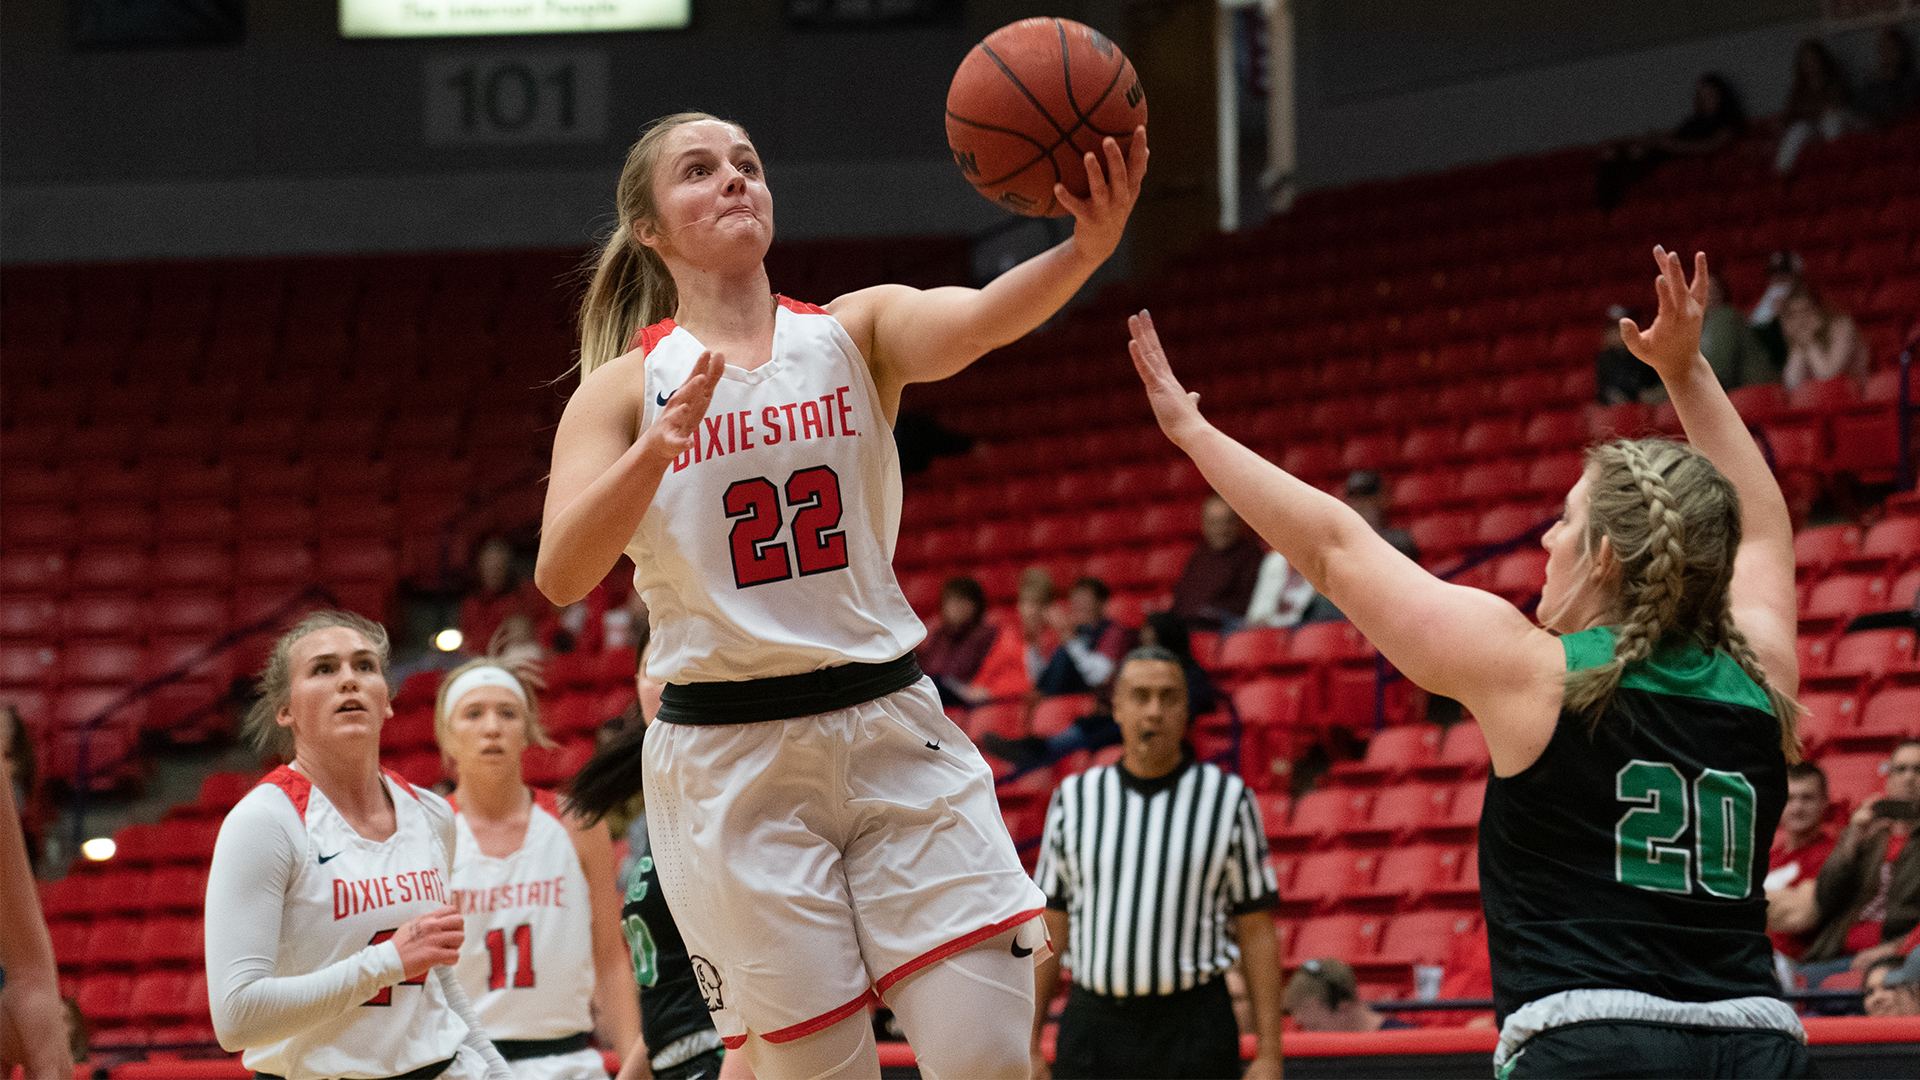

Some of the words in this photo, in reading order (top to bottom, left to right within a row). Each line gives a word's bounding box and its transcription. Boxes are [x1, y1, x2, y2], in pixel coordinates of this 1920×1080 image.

[450, 64, 576, 130] 101
[722, 464, 849, 589] 22
[1615, 759, 1757, 899] 20
[333, 876, 395, 921] DIXIE
[500, 876, 565, 909] STATE
[485, 922, 535, 992] 11
